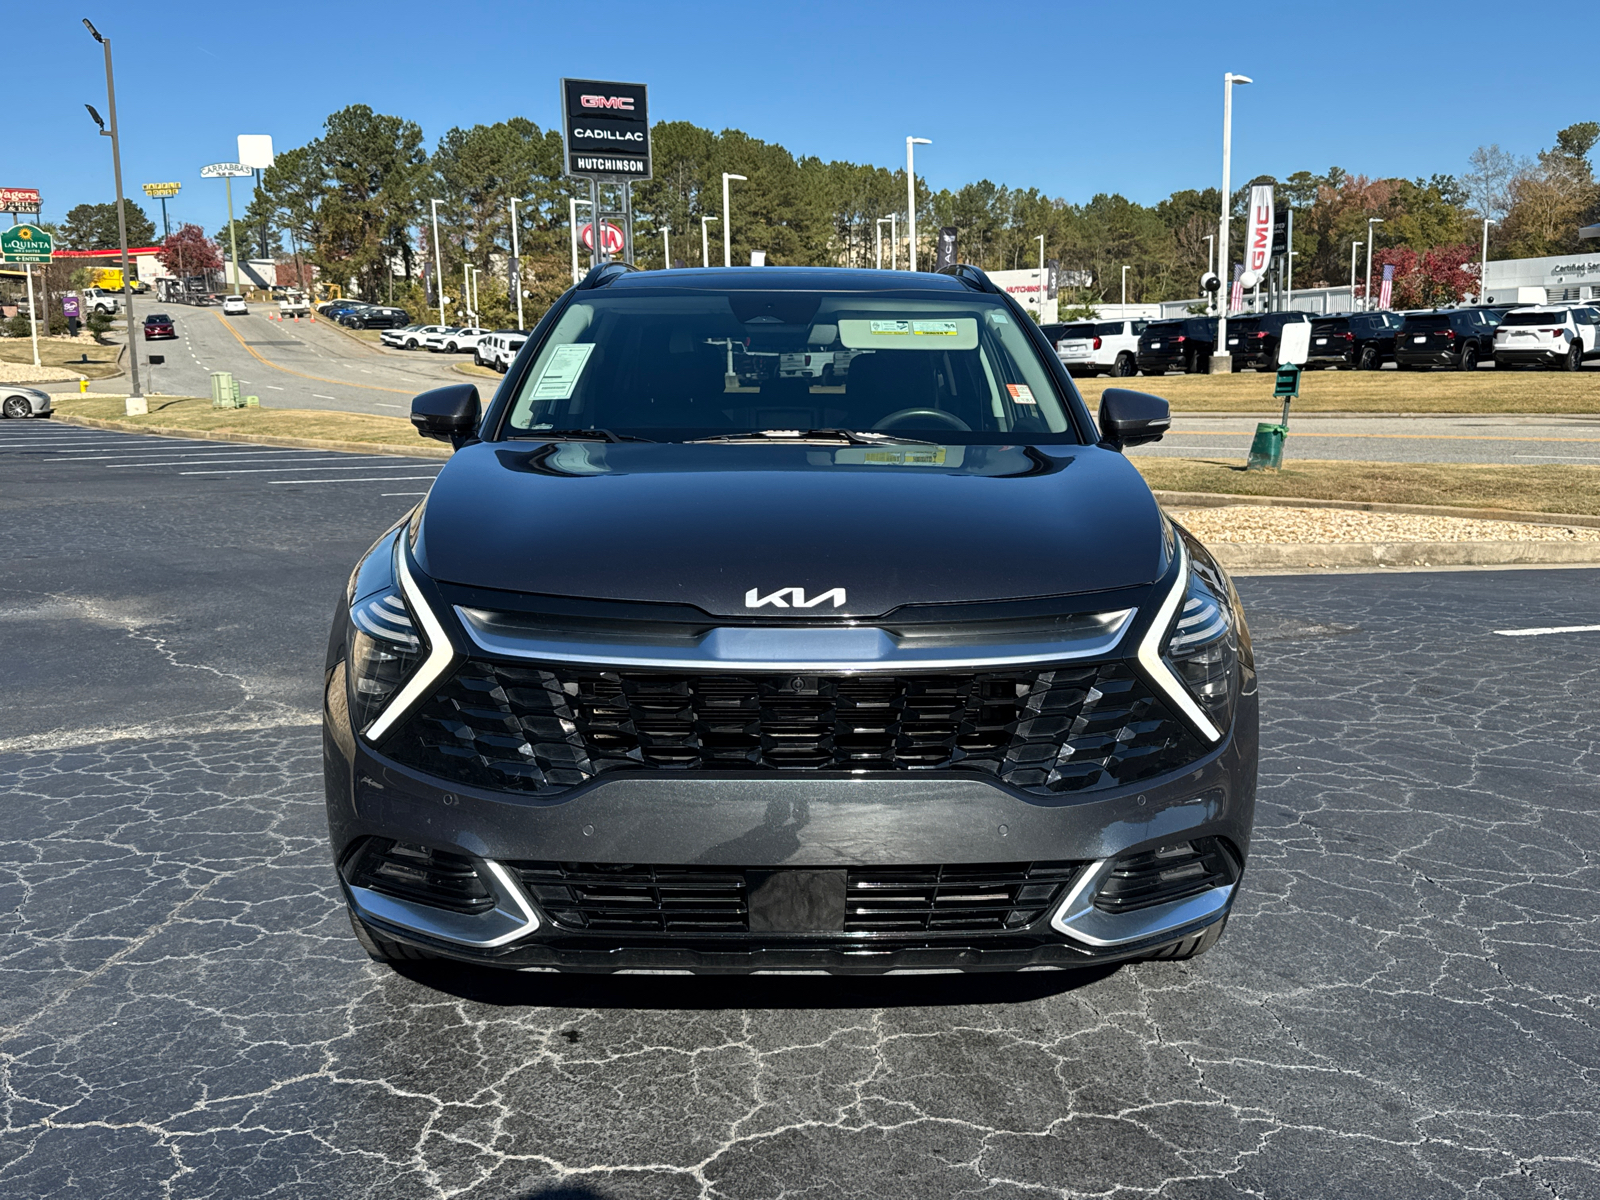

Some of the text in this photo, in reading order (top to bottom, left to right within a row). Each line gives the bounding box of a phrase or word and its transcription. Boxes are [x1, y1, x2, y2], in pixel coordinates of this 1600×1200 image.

[580, 94, 635, 110] GMC
[573, 128, 644, 141] CADILLAC
[577, 157, 644, 172] HUTCHINSON
[1251, 205, 1269, 271] GMC
[1554, 262, 1585, 273] Certified
[1005, 284, 1048, 294] HUTCHINSN
[744, 587, 847, 608] KIA
